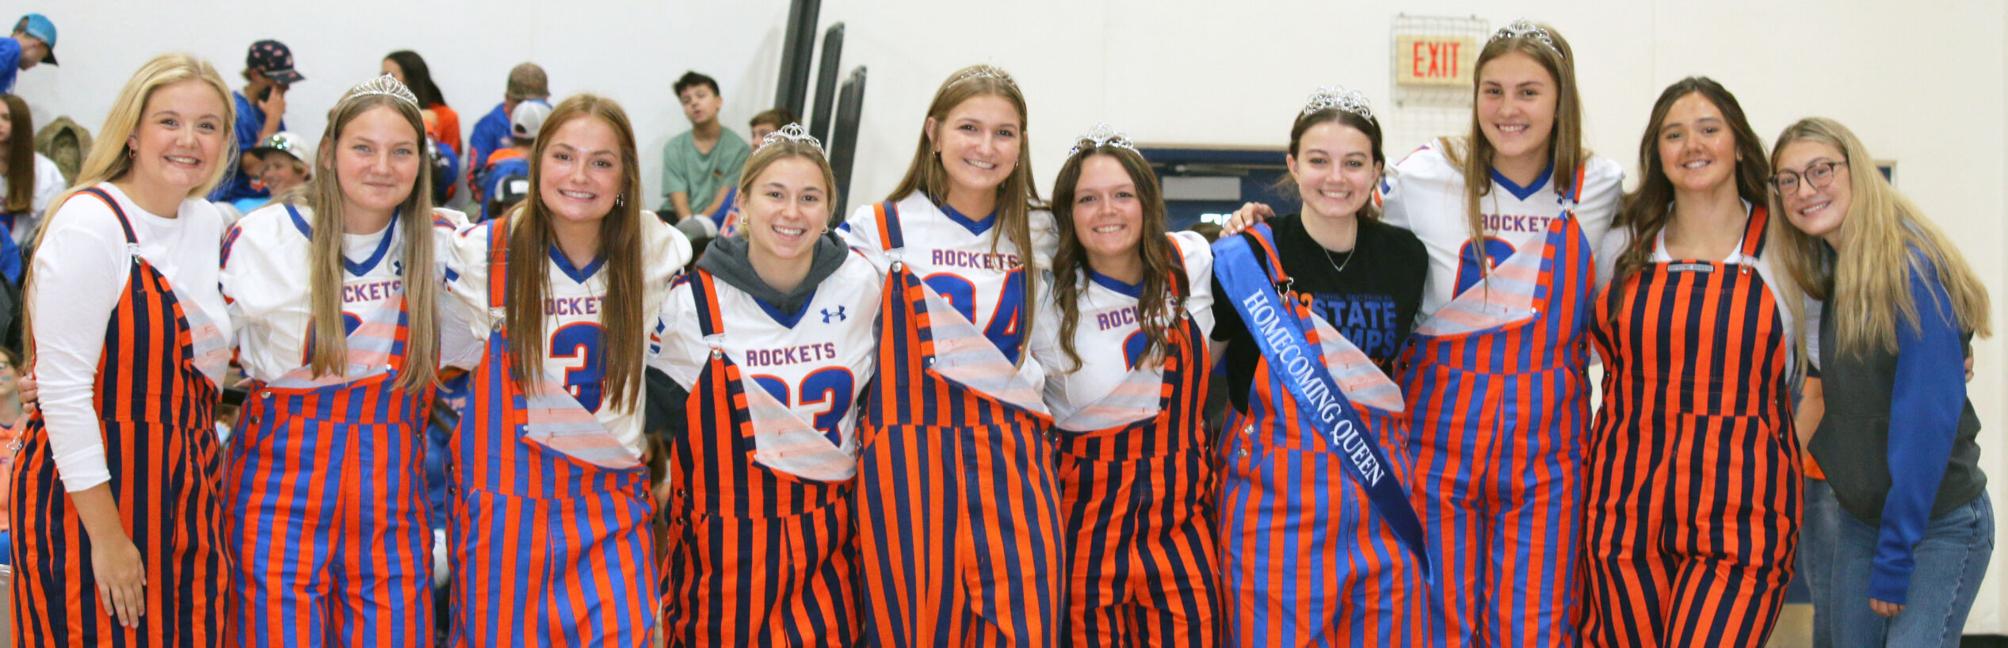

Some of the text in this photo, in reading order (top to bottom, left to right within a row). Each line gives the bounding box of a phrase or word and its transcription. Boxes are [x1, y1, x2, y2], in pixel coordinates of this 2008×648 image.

[1412, 41, 1461, 78] EXIT
[932, 248, 1018, 270] ROCKETS
[342, 280, 402, 303] CKETS
[1312, 298, 1397, 329] STATE
[745, 341, 836, 367] ROCKETS
[1244, 288, 1385, 488] HOMECOMING QUEEN
